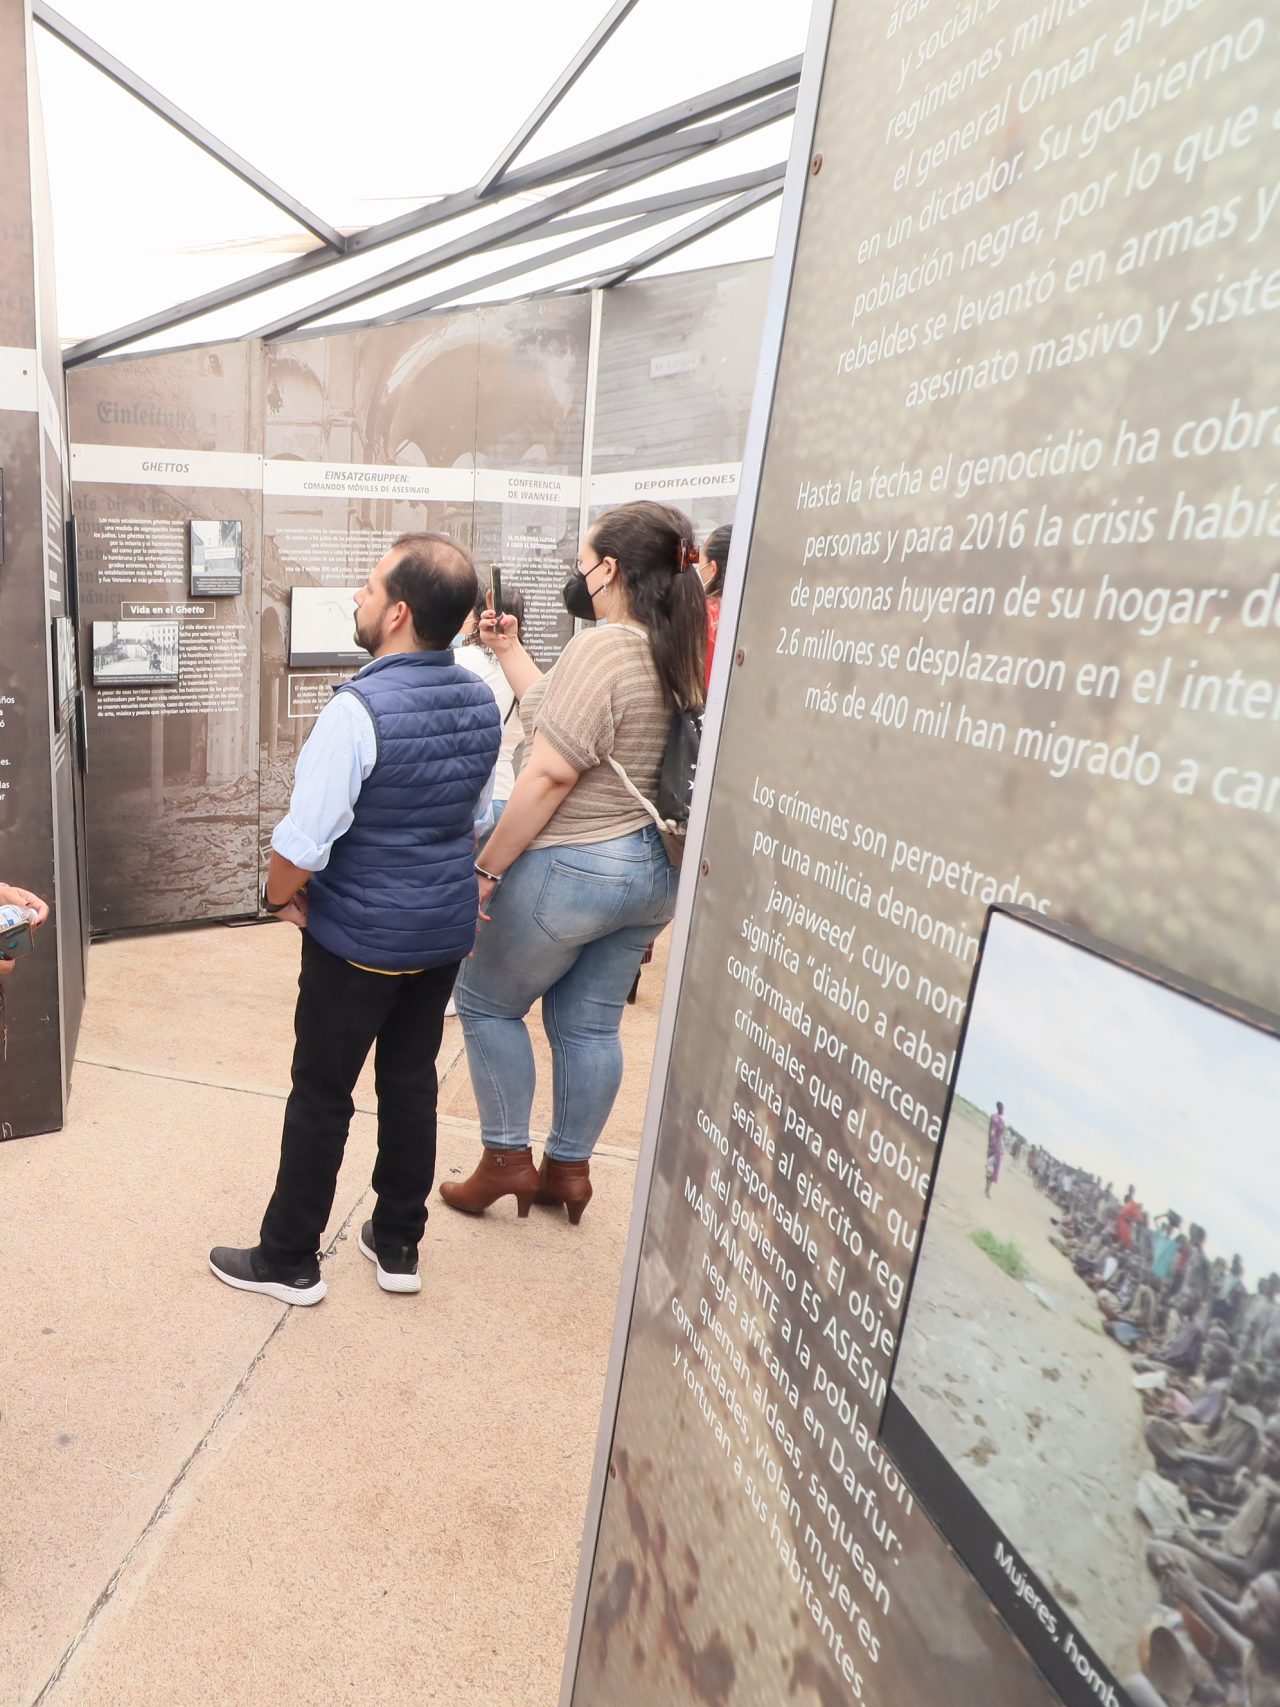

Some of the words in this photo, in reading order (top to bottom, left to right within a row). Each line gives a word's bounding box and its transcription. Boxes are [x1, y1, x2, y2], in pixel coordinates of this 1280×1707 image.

[836, 323, 919, 376] rebeldes
[923, 312, 947, 346] se
[953, 260, 1056, 335] levantó
[1064, 251, 1106, 294] en
[1116, 195, 1240, 274] armas
[1247, 183, 1280, 243] y
[142, 461, 190, 473] GHETTOS
[303, 482, 345, 491] COMANDOS
[347, 482, 378, 492] MÓVILES
[381, 485, 390, 493] DE
[392, 486, 430, 494] ASESINATO
[325, 470, 410, 483] EINSATZGRUPPEN:
[508, 478, 561, 490] CONFERENCIA
[508, 490, 519, 499] DE
[634, 474, 736, 491] DEPORTACIONES
[796, 478, 842, 511] Hasta
[845, 474, 863, 504] la
[868, 466, 923, 500] fecha
[929, 453, 953, 493] el
[955, 428, 1103, 499] genocidio
[1112, 420, 1159, 466] ha
[802, 530, 882, 567] personas
[882, 529, 900, 565] y
[900, 524, 954, 563] para
[959, 508, 1028, 551] 2016
[1034, 504, 1064, 547] la
[1072, 496, 1157, 546] crisis
[130, 605, 150, 614] Vida
[165, 605, 173, 614] el
[175, 605, 205, 614] Ghetto
[775, 628, 801, 656] 2.6
[801, 631, 875, 666] millones
[877, 643, 901, 670] se
[905, 637, 1066, 692] desplazaron
[1075, 663, 1120, 699] en
[1132, 657, 1172, 705] el
[804, 683, 839, 714] más
[842, 687, 866, 721] de
[869, 692, 909, 729] 400
[912, 702, 952, 739] mil
[955, 706, 1006, 752] han
[1013, 723, 1161, 786] migrado
[1171, 759, 1199, 795] a
[753, 776, 774, 811] Los
[779, 788, 848, 842] crímenes
[854, 823, 887, 857] son
[684, 1174, 780, 1320] MASIVAMENTE
[781, 1317, 793, 1341] a
[795, 1327, 810, 1369] la
[672, 1343, 683, 1367] y
[682, 1357, 732, 1458] torturan
[733, 1455, 743, 1479] a
[744, 1476, 768, 1524] sus
[702, 1251, 737, 1316] negra
[740, 1313, 799, 1411] africana
[803, 1406, 825, 1449] en
[829, 1443, 903, 1566] Darfur:
[699, 1297, 751, 1388] queman
[752, 1383, 803, 1480] aldeas,
[809, 1473, 891, 1616] saquean
[993, 1541, 1060, 1643] Mujeres,
